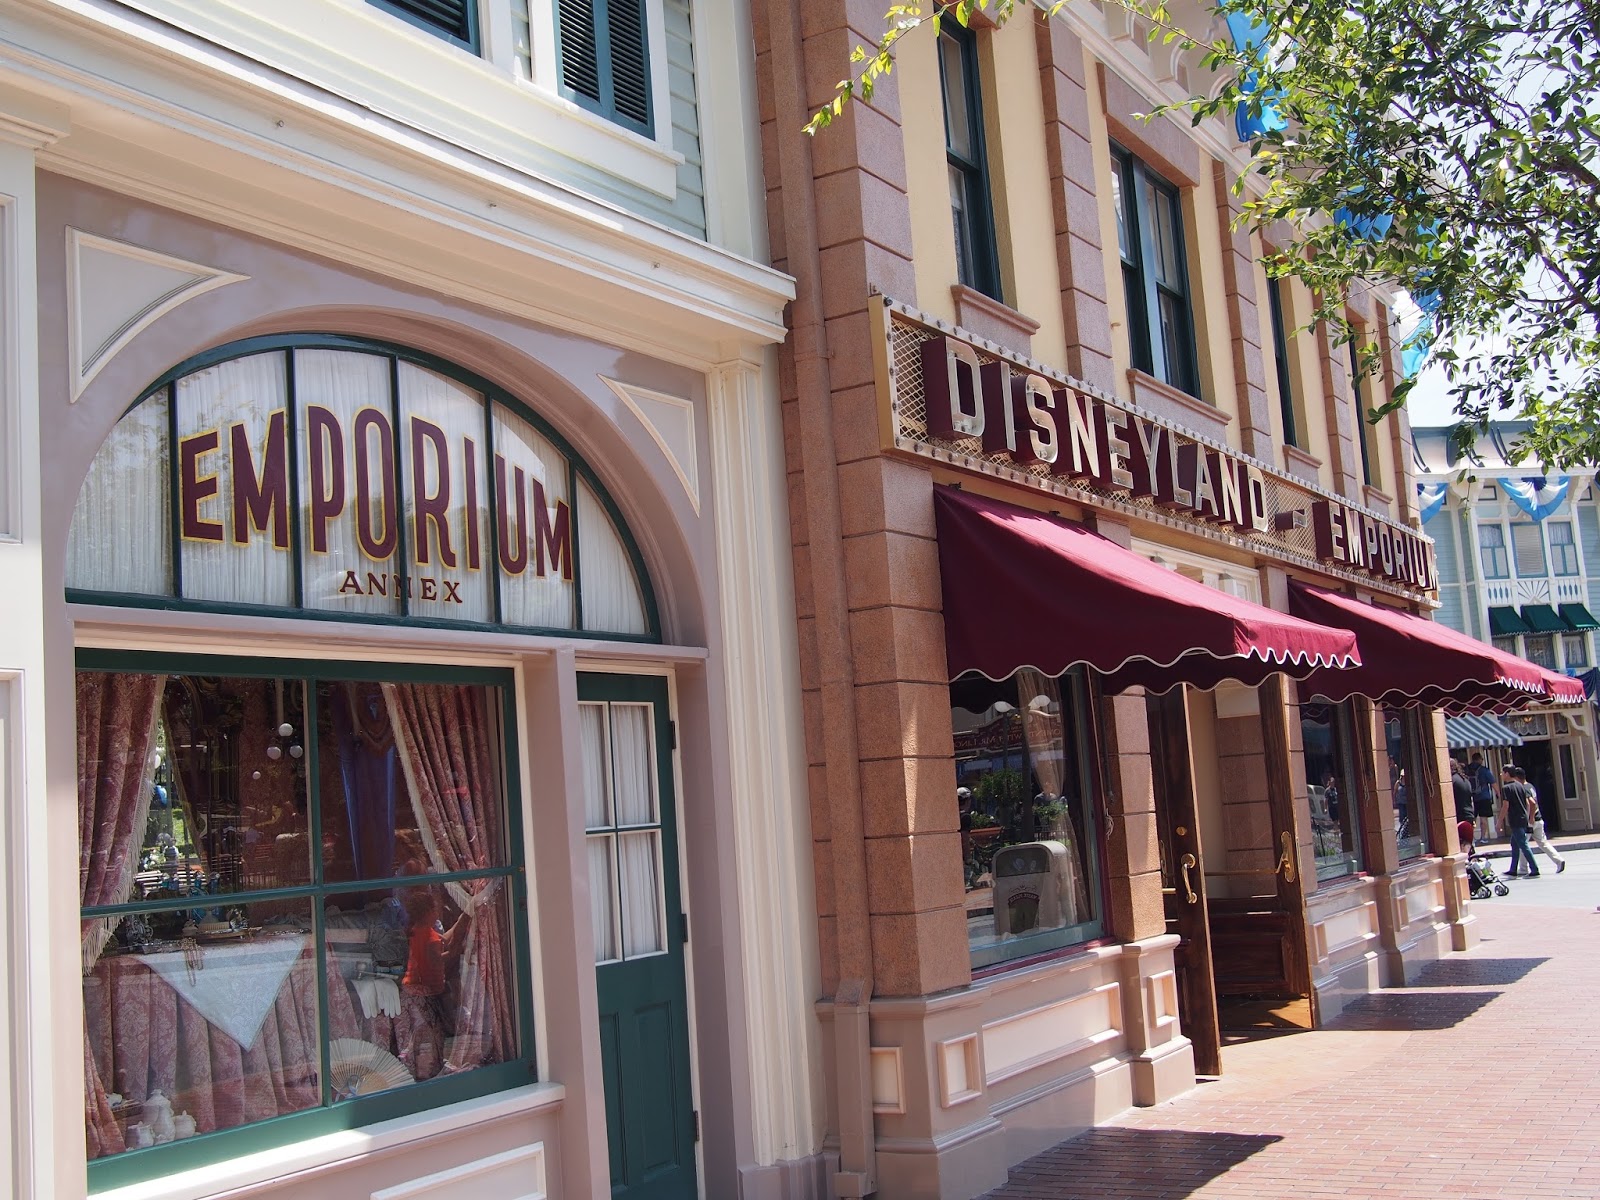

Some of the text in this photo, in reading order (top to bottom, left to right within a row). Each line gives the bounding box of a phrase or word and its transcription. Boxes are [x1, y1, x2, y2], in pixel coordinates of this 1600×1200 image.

[178, 403, 574, 583] EMPORIUM
[940, 335, 1268, 533] DISNEYLAND
[1325, 499, 1438, 590] EMPORIUM
[338, 570, 463, 604] ANNEX
